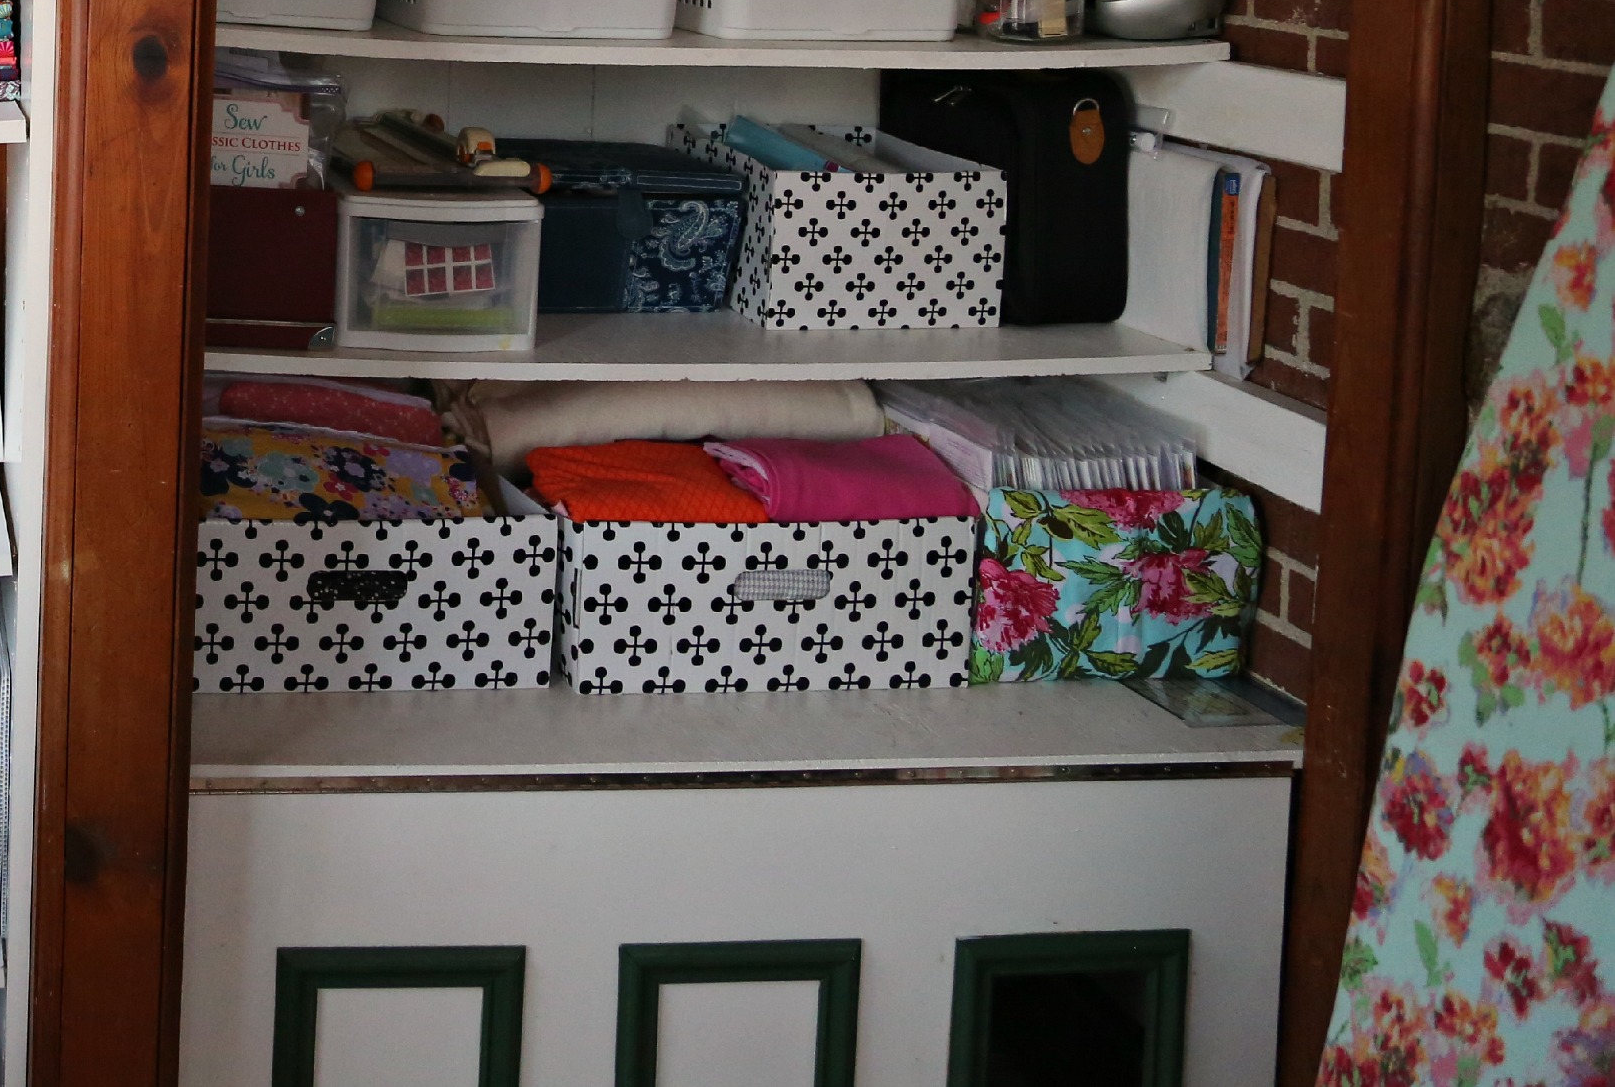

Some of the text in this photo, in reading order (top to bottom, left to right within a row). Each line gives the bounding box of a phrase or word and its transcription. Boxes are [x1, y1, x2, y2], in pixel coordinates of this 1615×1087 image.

[224, 103, 268, 131] Sew
[211, 136, 301, 152] SSIC CLOTHES
[231, 154, 275, 186] Girls
